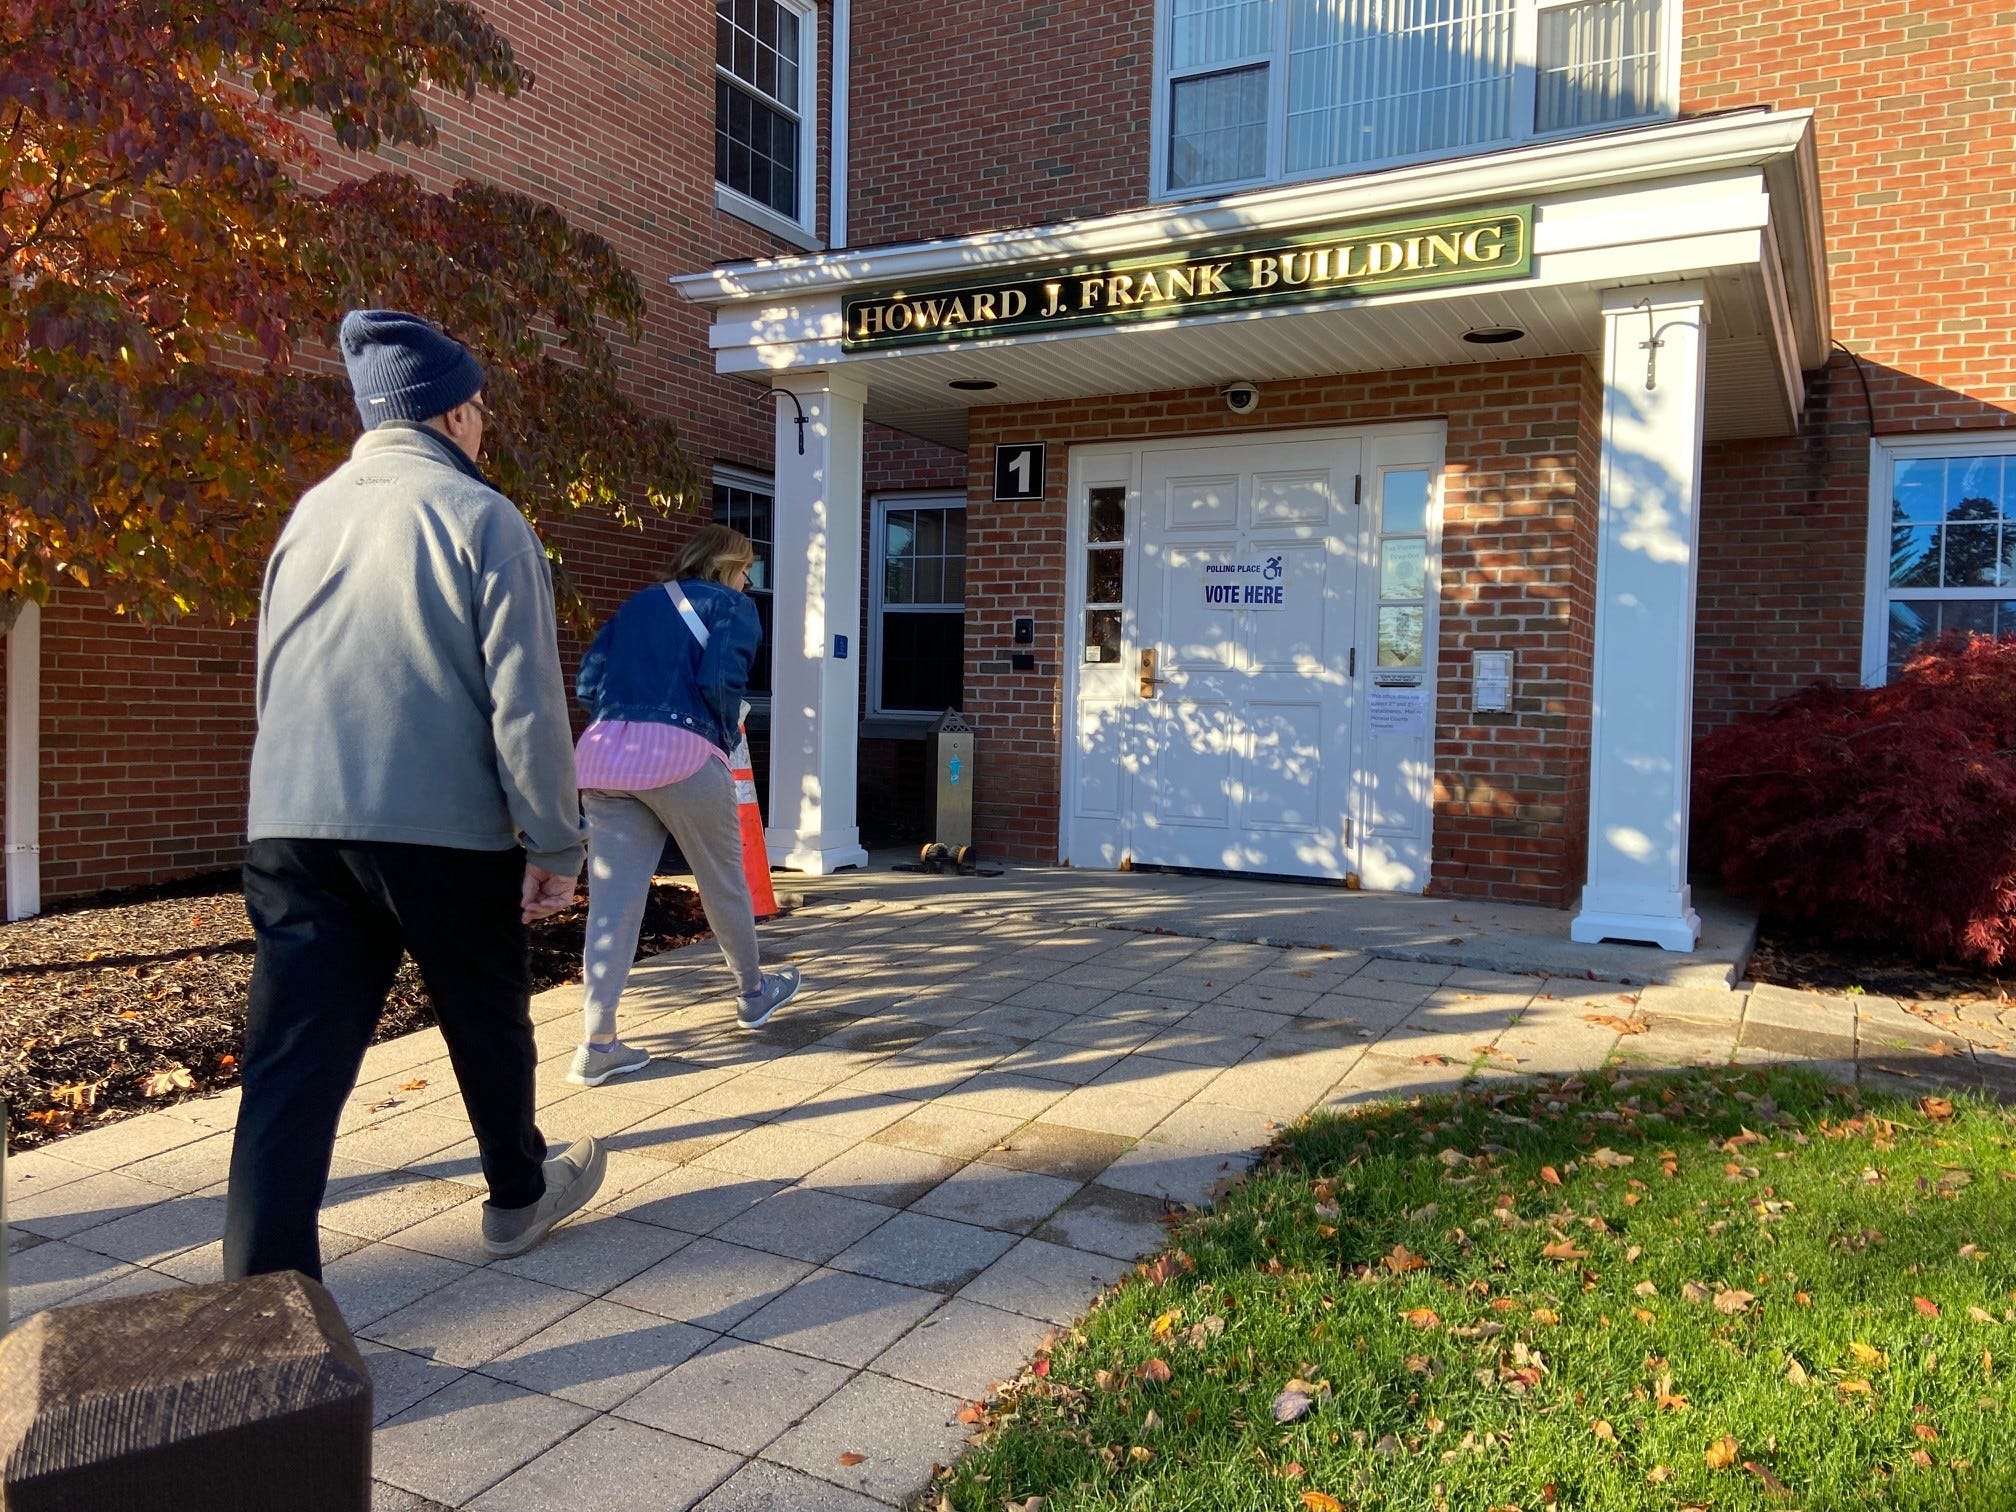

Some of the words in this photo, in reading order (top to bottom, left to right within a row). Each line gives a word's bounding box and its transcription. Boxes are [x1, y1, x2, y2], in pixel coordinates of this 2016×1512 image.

[857, 289, 1027, 336] HOWARD
[1040, 283, 1067, 317] J.
[1078, 262, 1232, 310] FRANK
[1248, 225, 1506, 290] BUILDING
[1008, 450, 1031, 493] 1
[1206, 565, 1236, 573] POLLING
[1237, 565, 1261, 573] PLACE
[1205, 585, 1240, 603] VOTE
[1244, 585, 1284, 604] HERE
